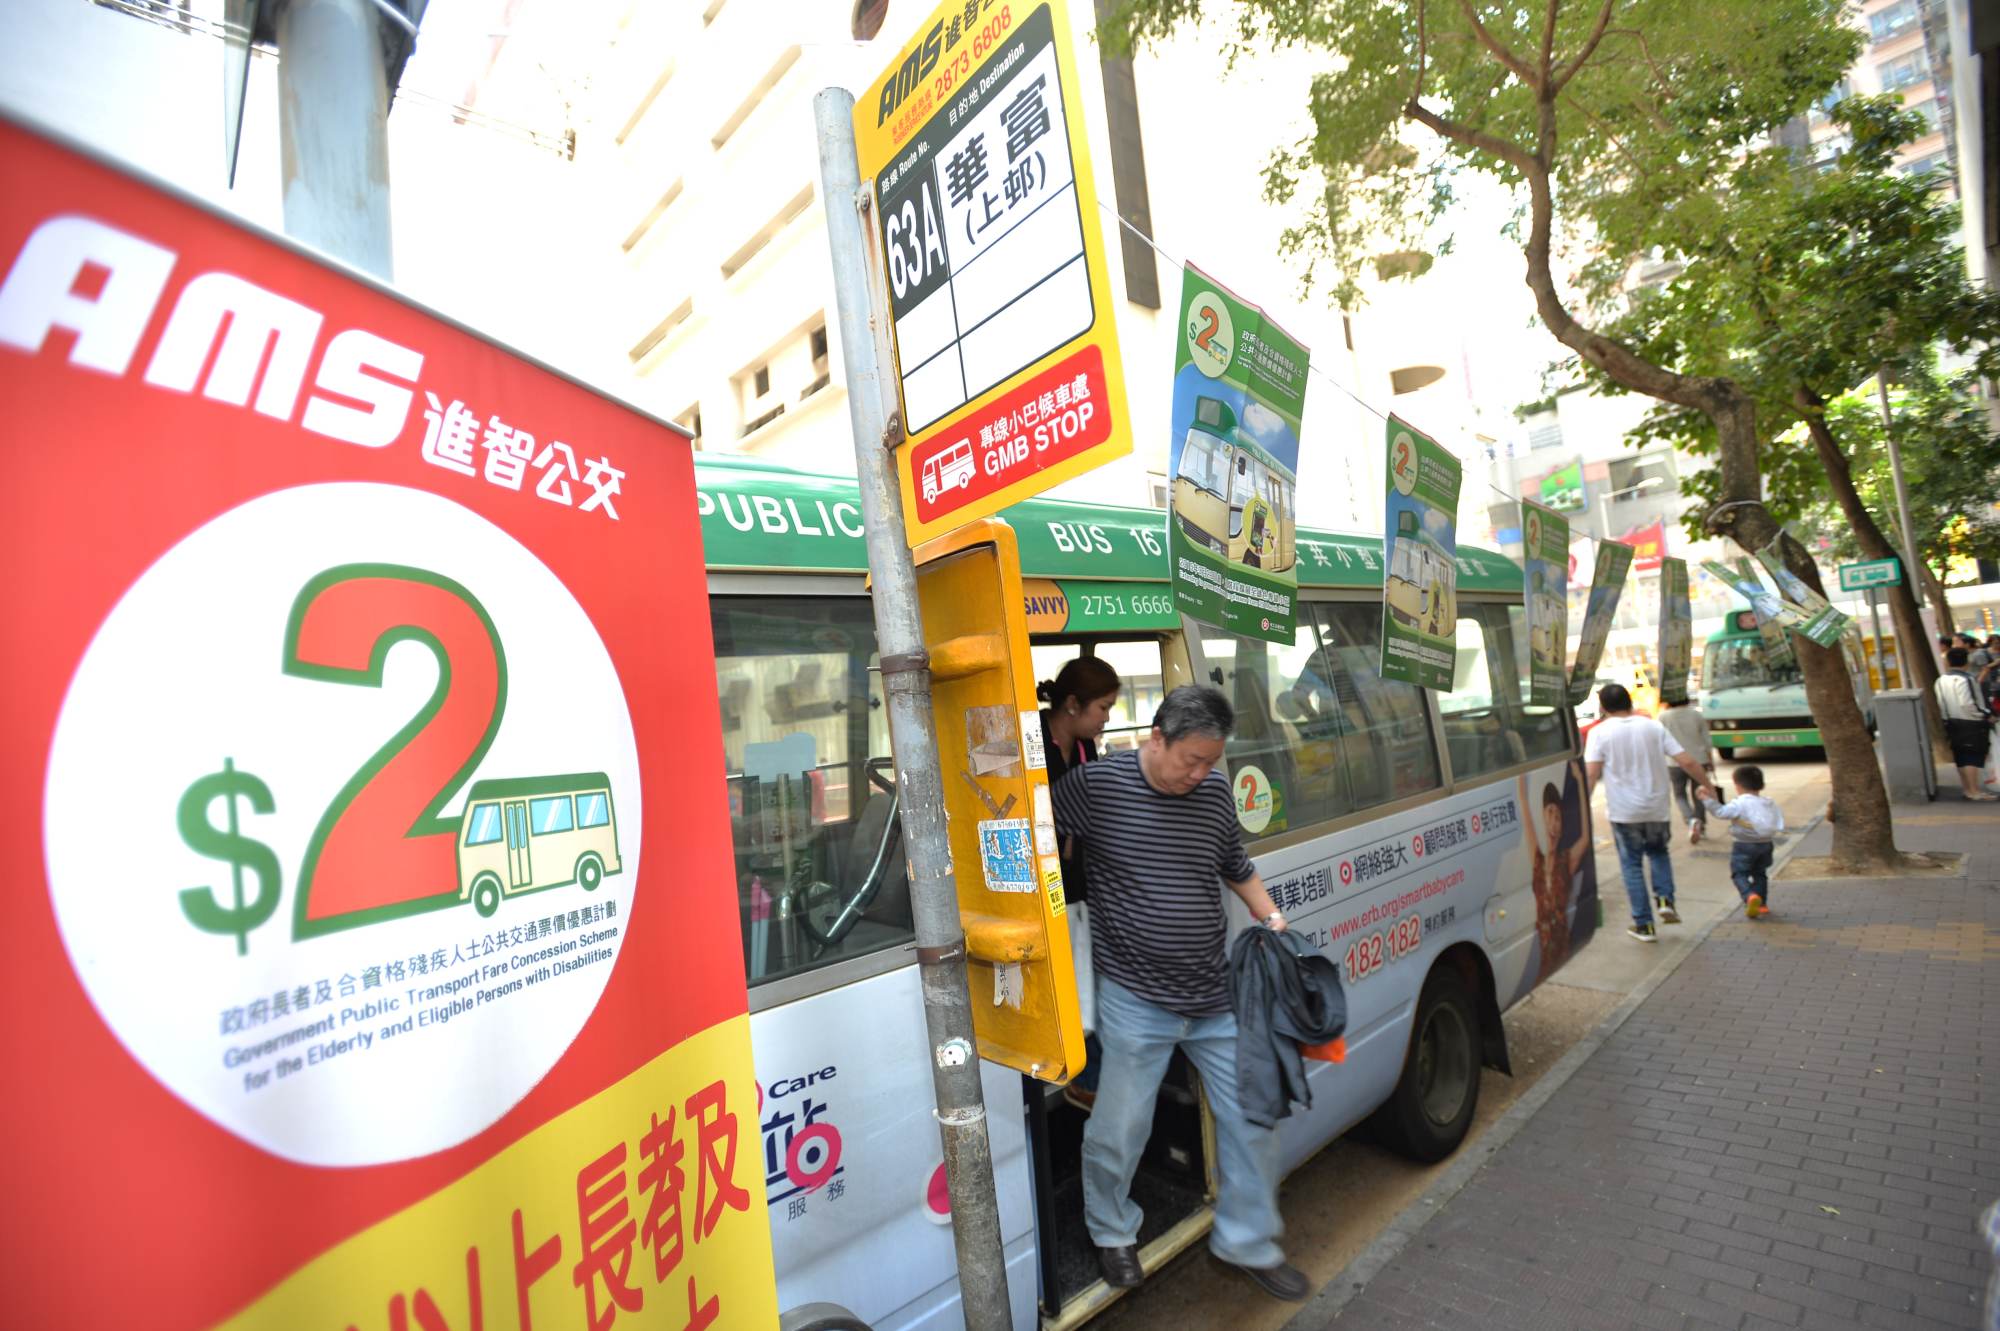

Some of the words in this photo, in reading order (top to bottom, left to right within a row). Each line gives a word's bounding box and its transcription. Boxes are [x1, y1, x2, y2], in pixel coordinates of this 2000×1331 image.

[878, 17, 944, 128] AMS
[935, 50, 970, 101] 2873
[973, 4, 1012, 60] 6808
[949, 87, 979, 126] 目的地
[980, 42, 1025, 95] Destination
[881, 168, 899, 195] 路線
[899, 151, 918, 176] Route
[917, 141, 931, 158] No.
[945, 73, 1051, 208] 華富
[887, 181, 945, 299] 63A
[0, 213, 424, 448] AMS
[1189, 305, 1219, 352] $2
[979, 372, 1091, 449] 專線小巴候車處
[983, 437, 1030, 477] GMB
[1035, 401, 1094, 452] STOP
[421, 390, 626, 520] 進智公交
[697, 491, 865, 538] PUBLIC
[1048, 522, 1112, 554] BUS
[1129, 528, 1162, 556] 16
[1024, 596, 1066, 616] SAVVY
[1080, 596, 1127, 616] 2751
[1131, 595, 1172, 615] 6666
[176, 562, 508, 956] $2
[1353, 840, 1409, 884] 網絡強大
[1423, 818, 1469, 856] 顧問服務
[219, 899, 617, 1037] 政府長者及合資格殘疾人士公共交通票價優惠計劃
[1346, 933, 1383, 982] 182
[1387, 916, 1420, 961] 182
[223, 1012, 336, 1069] Government
[340, 996, 400, 1027] Public
[406, 969, 480, 1006] Transport
[483, 961, 509, 982] Fare
[511, 939, 578, 970] Concession
[580, 926, 618, 949] Scheme
[243, 1068, 272, 1093] for
[275, 1056, 304, 1079] the
[306, 1029, 374, 1067] Elderly
[380, 1015, 414, 1041] and
[418, 997, 474, 1028] Eligible
[476, 978, 523, 1007] Persons
[525, 966, 551, 988] with
[553, 945, 613, 977] Disabilities
[768, 1065, 837, 1099] Care
[787, 1178, 846, 1222] 服務
